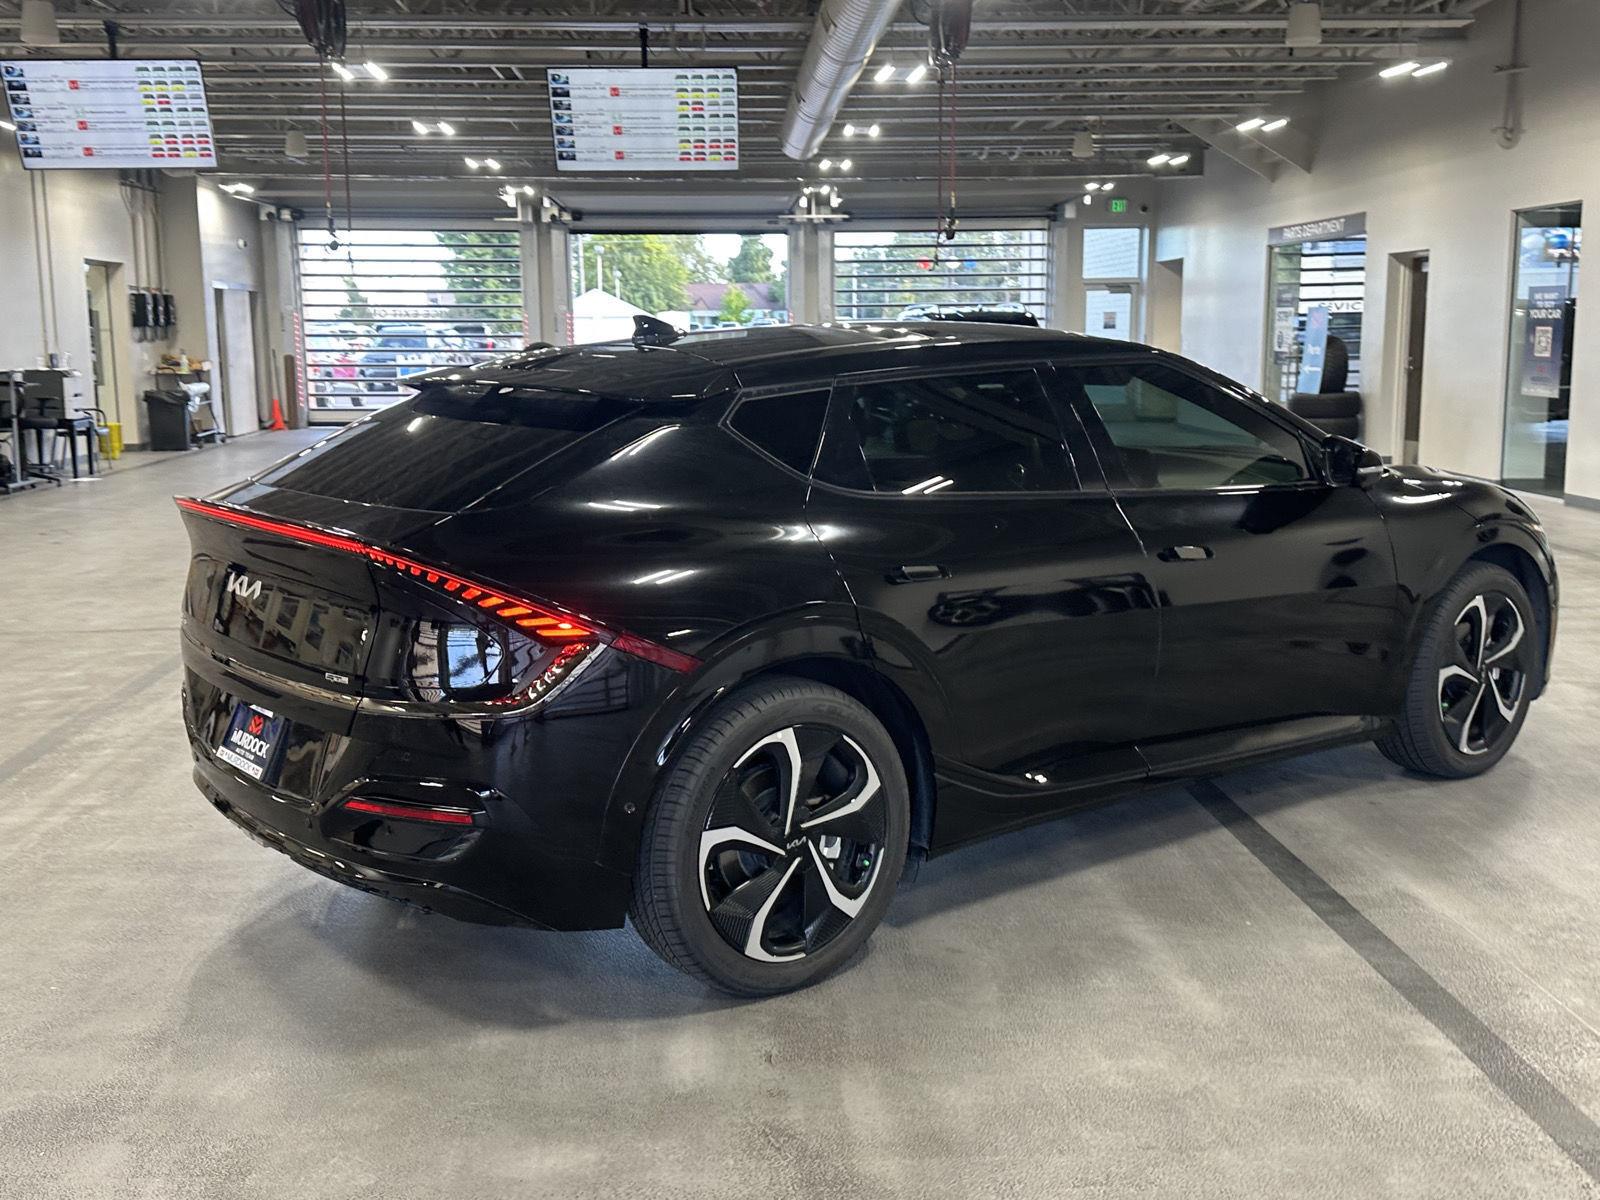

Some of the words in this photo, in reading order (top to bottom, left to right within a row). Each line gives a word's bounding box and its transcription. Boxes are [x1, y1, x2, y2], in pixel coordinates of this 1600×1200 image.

[1112, 199, 1127, 212] EXIT
[1283, 226, 1302, 239] PARTS
[1302, 218, 1345, 237] DEPARTMENT
[1529, 309, 1547, 319] YOUR
[1547, 309, 1562, 319] CAR
[227, 572, 262, 600] KIA
[230, 727, 271, 759] MURDOCK
